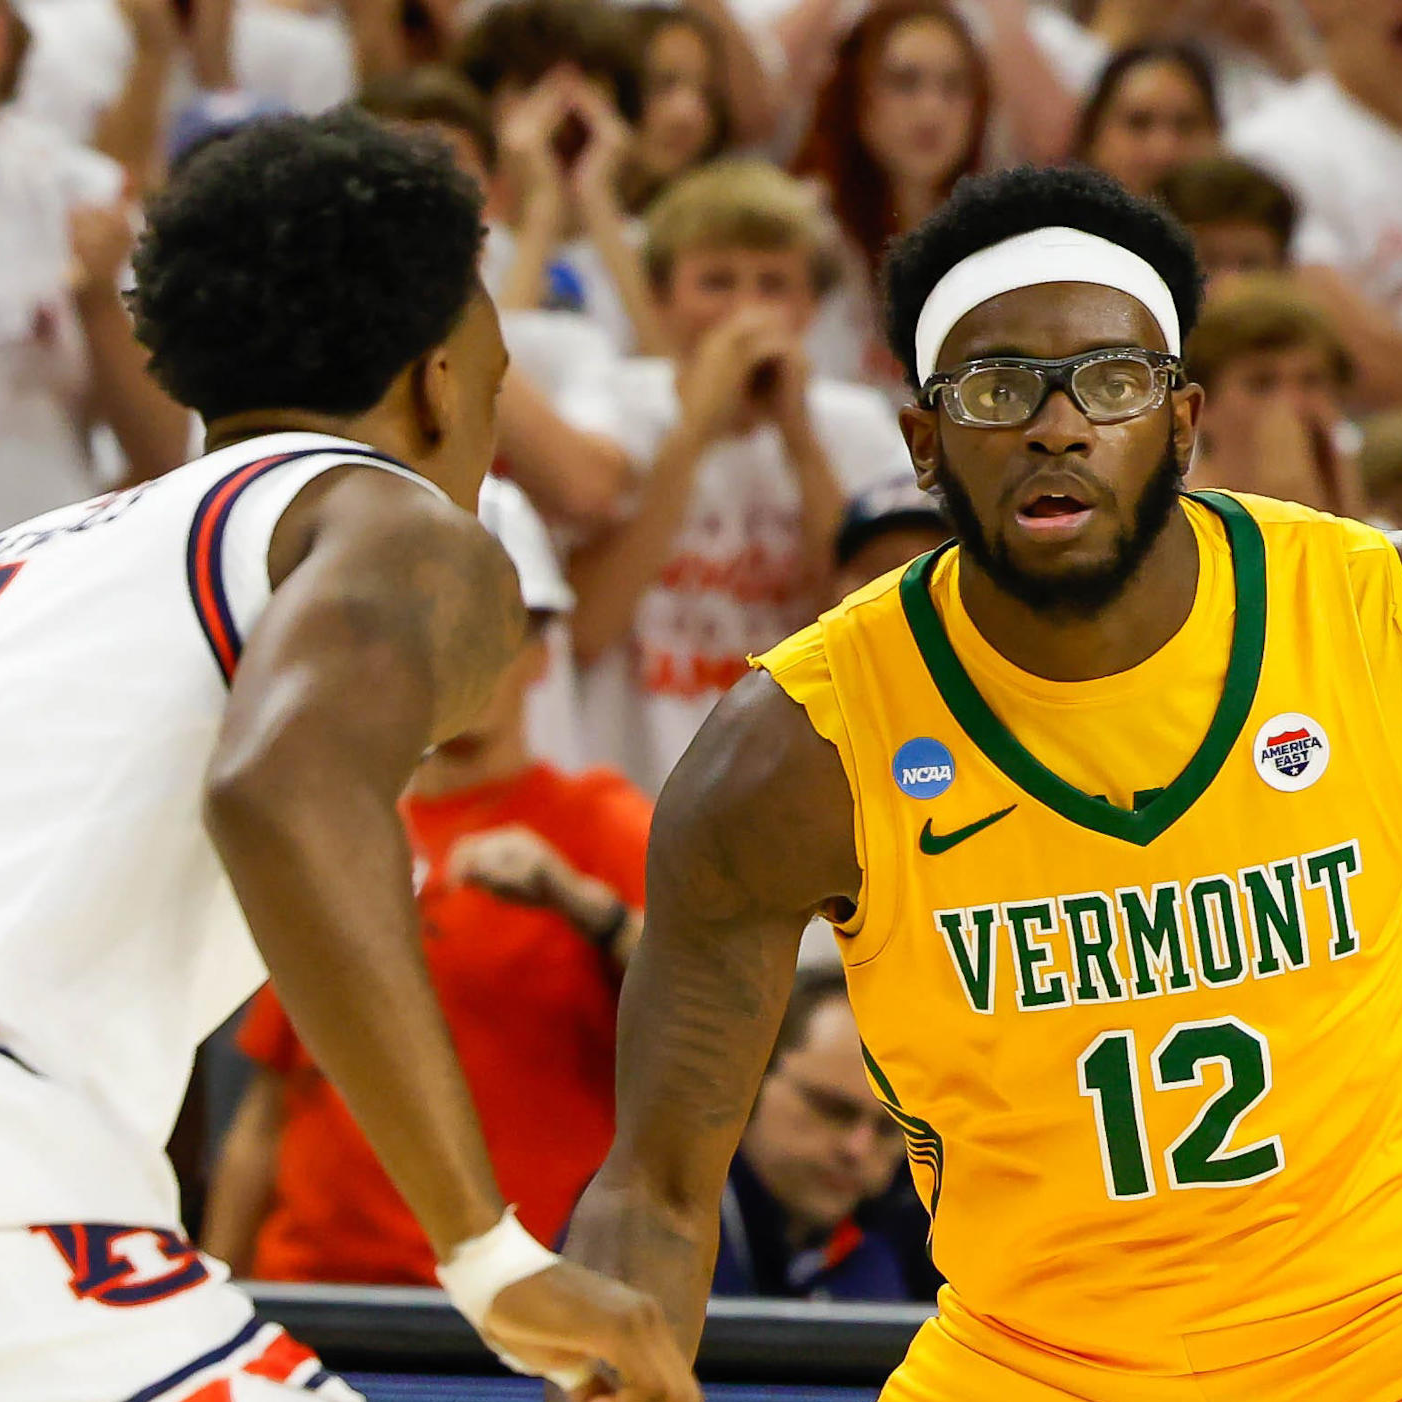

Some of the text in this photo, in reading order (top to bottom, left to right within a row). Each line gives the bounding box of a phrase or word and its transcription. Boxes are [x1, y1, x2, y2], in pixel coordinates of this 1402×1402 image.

[1261, 736, 1323, 763] AMERICA
[1274, 749, 1309, 768] EAST
[902, 765, 952, 785] NCAA
[934, 838, 1362, 1015] VERMONT
[1077, 1015, 1285, 1201] 12
